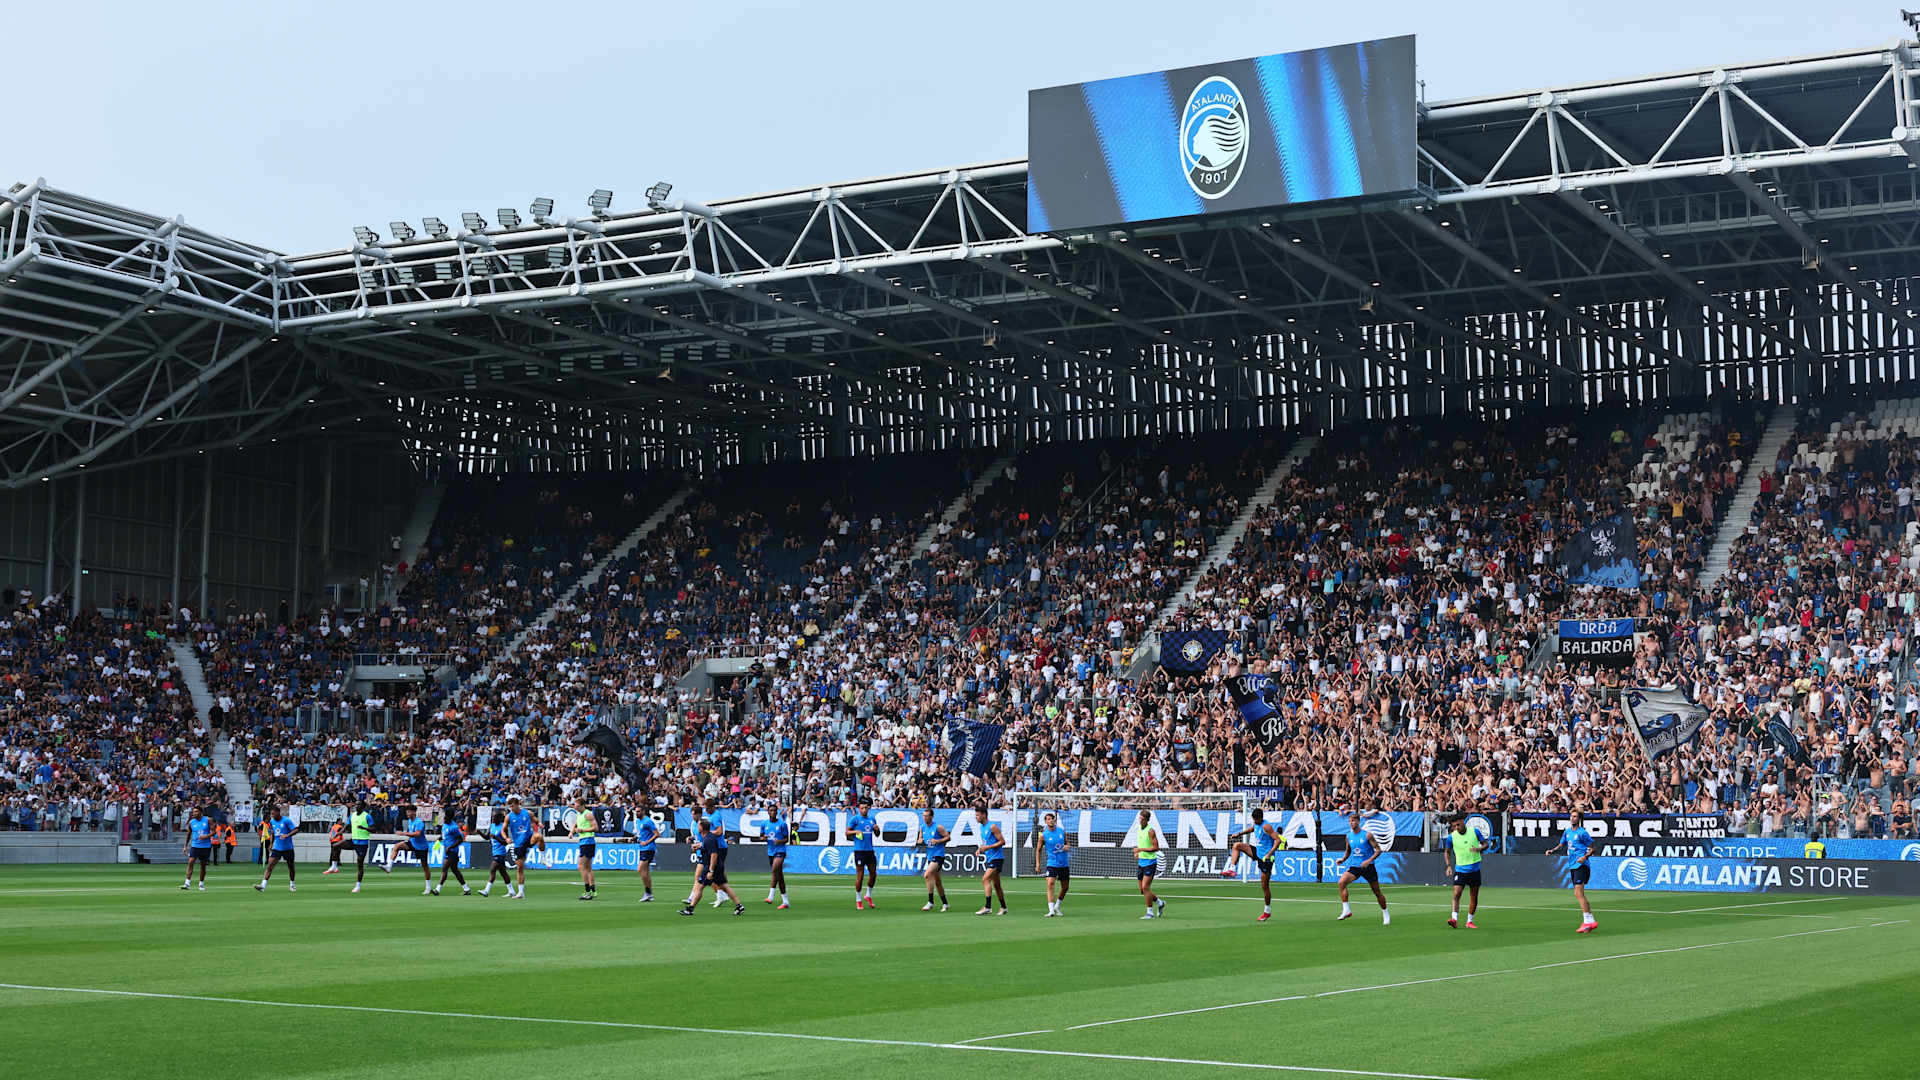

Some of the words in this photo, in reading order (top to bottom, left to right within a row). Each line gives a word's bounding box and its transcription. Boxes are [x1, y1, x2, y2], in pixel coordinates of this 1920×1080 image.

[1191, 93, 1238, 113] ATALANTA
[1200, 170, 1227, 185] 1907
[1579, 621, 1617, 634] ORDA
[1562, 639, 1633, 654] BALORDA
[1237, 775, 1258, 786] PER
[1260, 775, 1279, 786] CHI
[739, 810, 920, 847] SOLO
[1676, 817, 1718, 829] TANTO
[372, 843, 466, 865] ATALNA
[525, 849, 603, 866] ATALANA
[1601, 845, 1705, 858] ATALANTA
[845, 852, 929, 871] ALANT
[942, 853, 987, 872] STOR
[1172, 855, 1276, 875] ATALAN
[1282, 857, 1347, 877] STORE
[1655, 864, 1782, 887] ATALANTA
[1789, 866, 1869, 888] STORE
